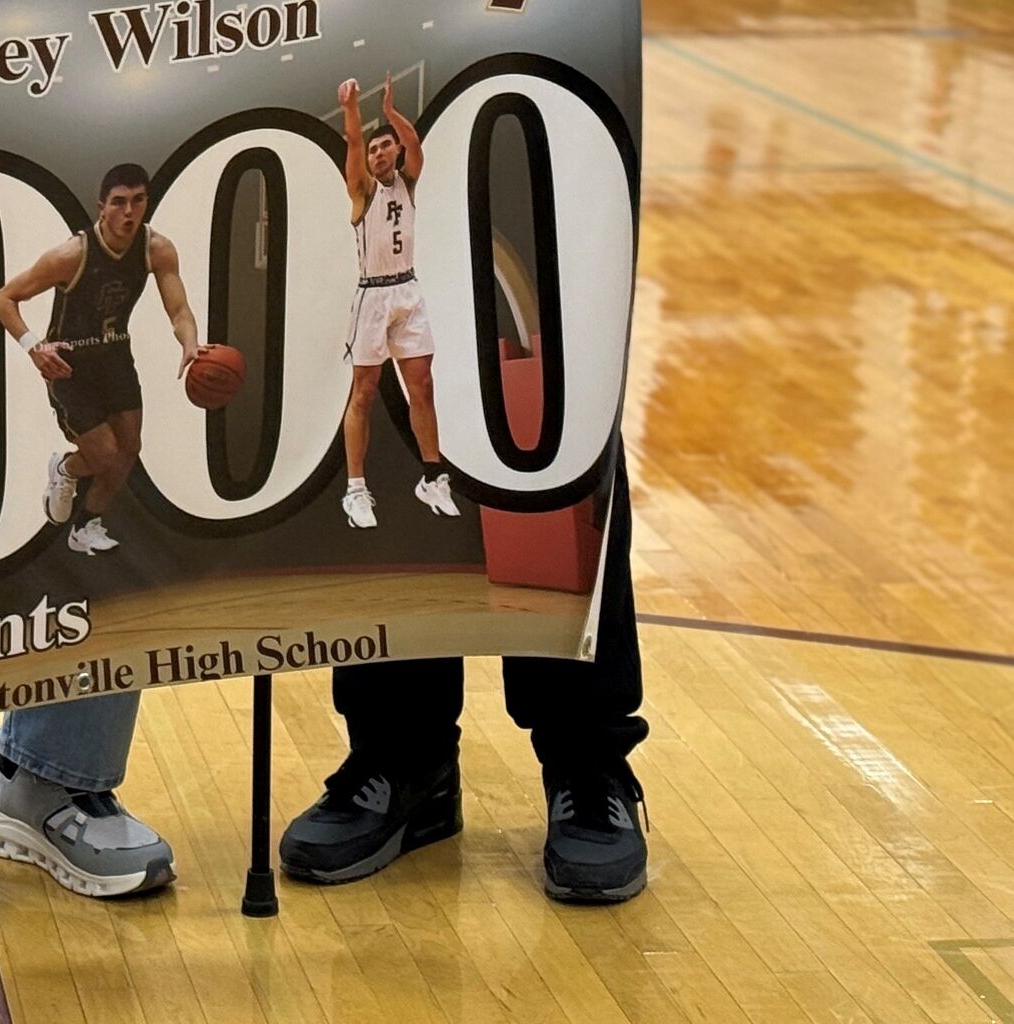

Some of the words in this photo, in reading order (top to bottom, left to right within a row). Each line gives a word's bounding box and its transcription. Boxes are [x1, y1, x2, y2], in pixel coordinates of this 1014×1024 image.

[393, 230, 403, 255] 5
[145, 641, 245, 685] High
[257, 624, 390, 672] School
